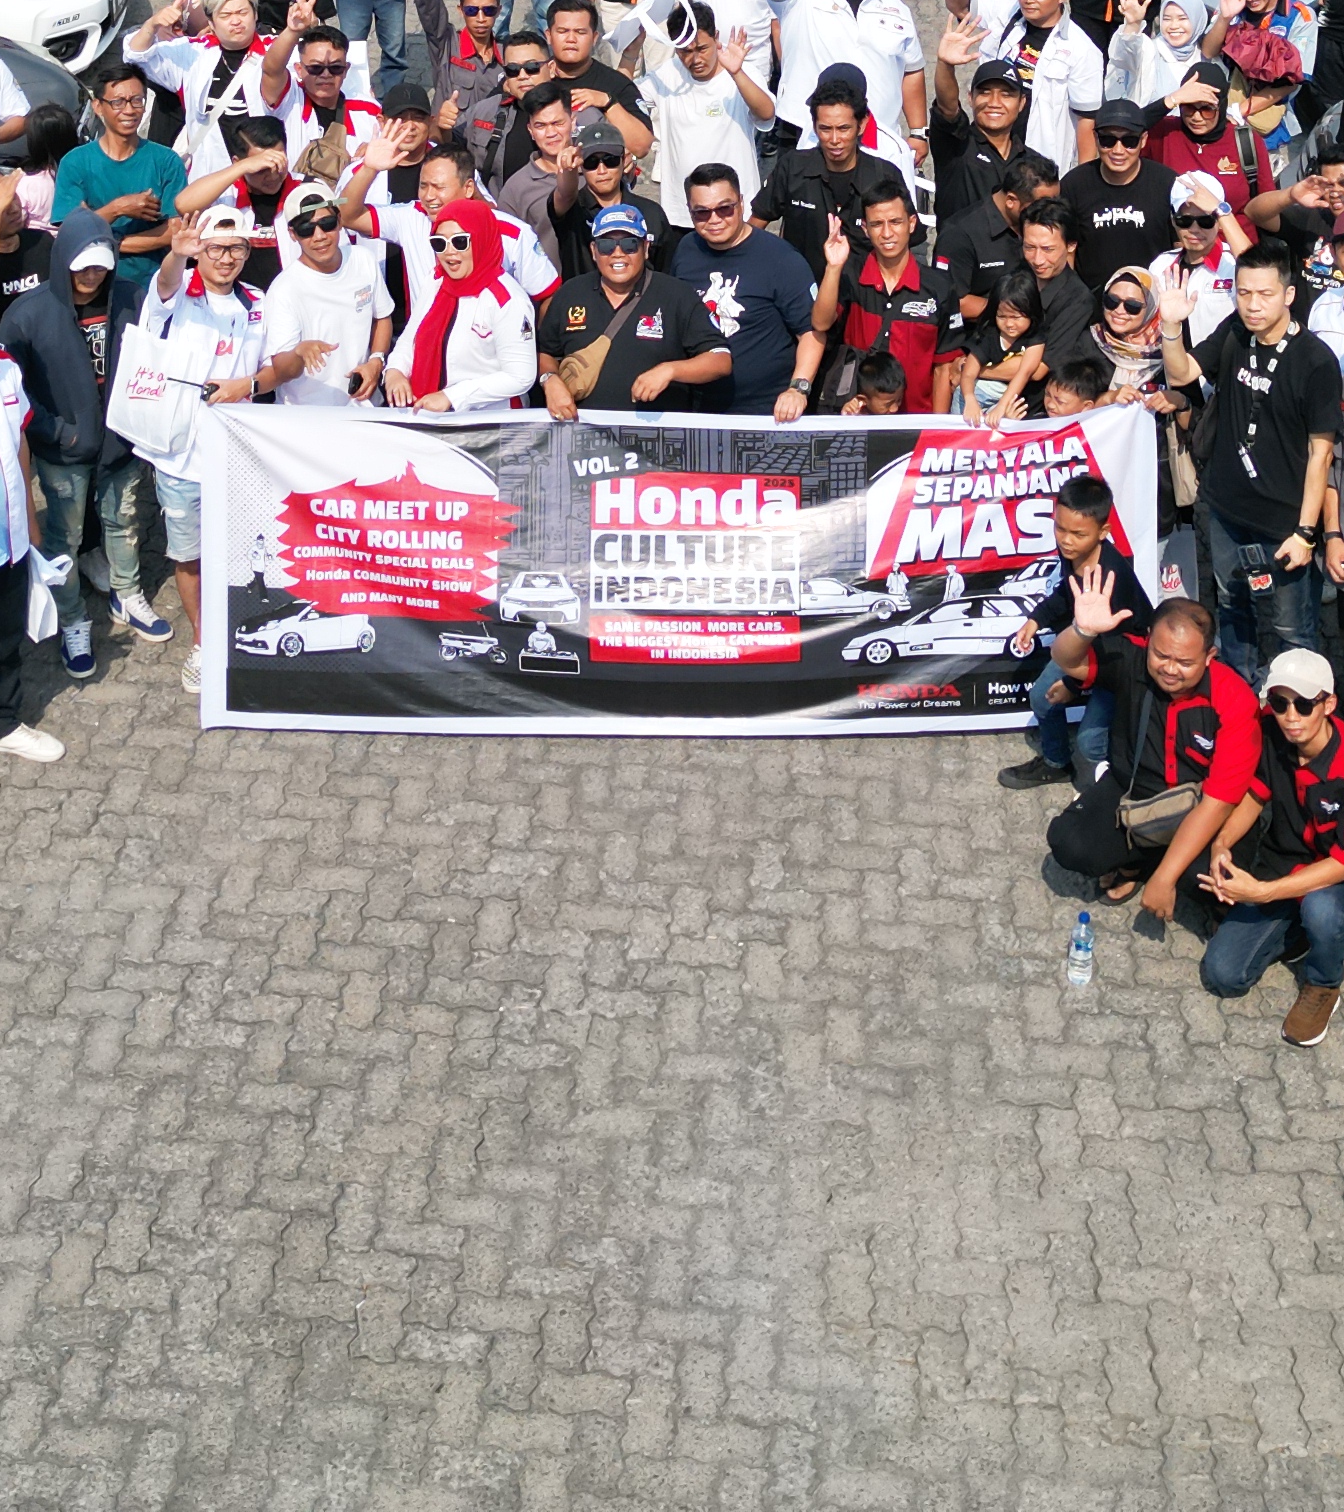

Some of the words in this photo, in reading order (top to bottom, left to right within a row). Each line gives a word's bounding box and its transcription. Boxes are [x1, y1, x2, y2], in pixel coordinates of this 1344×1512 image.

[3, 274, 40, 295] HNCI
[135, 366, 154, 381] It's
[157, 372, 164, 382] a
[573, 455, 619, 477] VOL.
[624, 452, 639, 470] 2
[920, 436, 1088, 473] MENYALA
[310, 498, 356, 520] CAR
[363, 500, 429, 521] MEET
[436, 501, 469, 522] UP
[594, 478, 797, 527] Honda
[763, 477, 795, 488] 2025
[315, 523, 360, 545] CITY
[367, 530, 463, 550] ROLLING
[895, 498, 1058, 564] MAS
[293, 546, 372, 563] COMMUNITY
[376, 554, 428, 569] SPECIAL
[432, 557, 474, 570] DEALS
[594, 533, 796, 572] CULTURE
[306, 568, 350, 581] Honda
[353, 569, 430, 589] COMMUNITY
[432, 579, 472, 593] SHOW
[594, 576, 796, 605] INDONESIA
[340, 592, 367, 604] AND
[369, 593, 403, 604] MANY
[406, 597, 440, 610] MORE
[605, 621, 641, 633] SAME
[708, 621, 745, 632] MORE
[599, 637, 623, 647] THE
[625, 636, 679, 648] BIGGEST
[650, 648, 664, 659] IN
[668, 648, 739, 660] INDONESIA
[858, 683, 962, 700] HONDA
[988, 682, 1020, 694] How
[858, 700, 875, 710] The
[878, 700, 911, 710] Power
[913, 700, 921, 708] of
[924, 700, 962, 708] Dreams
